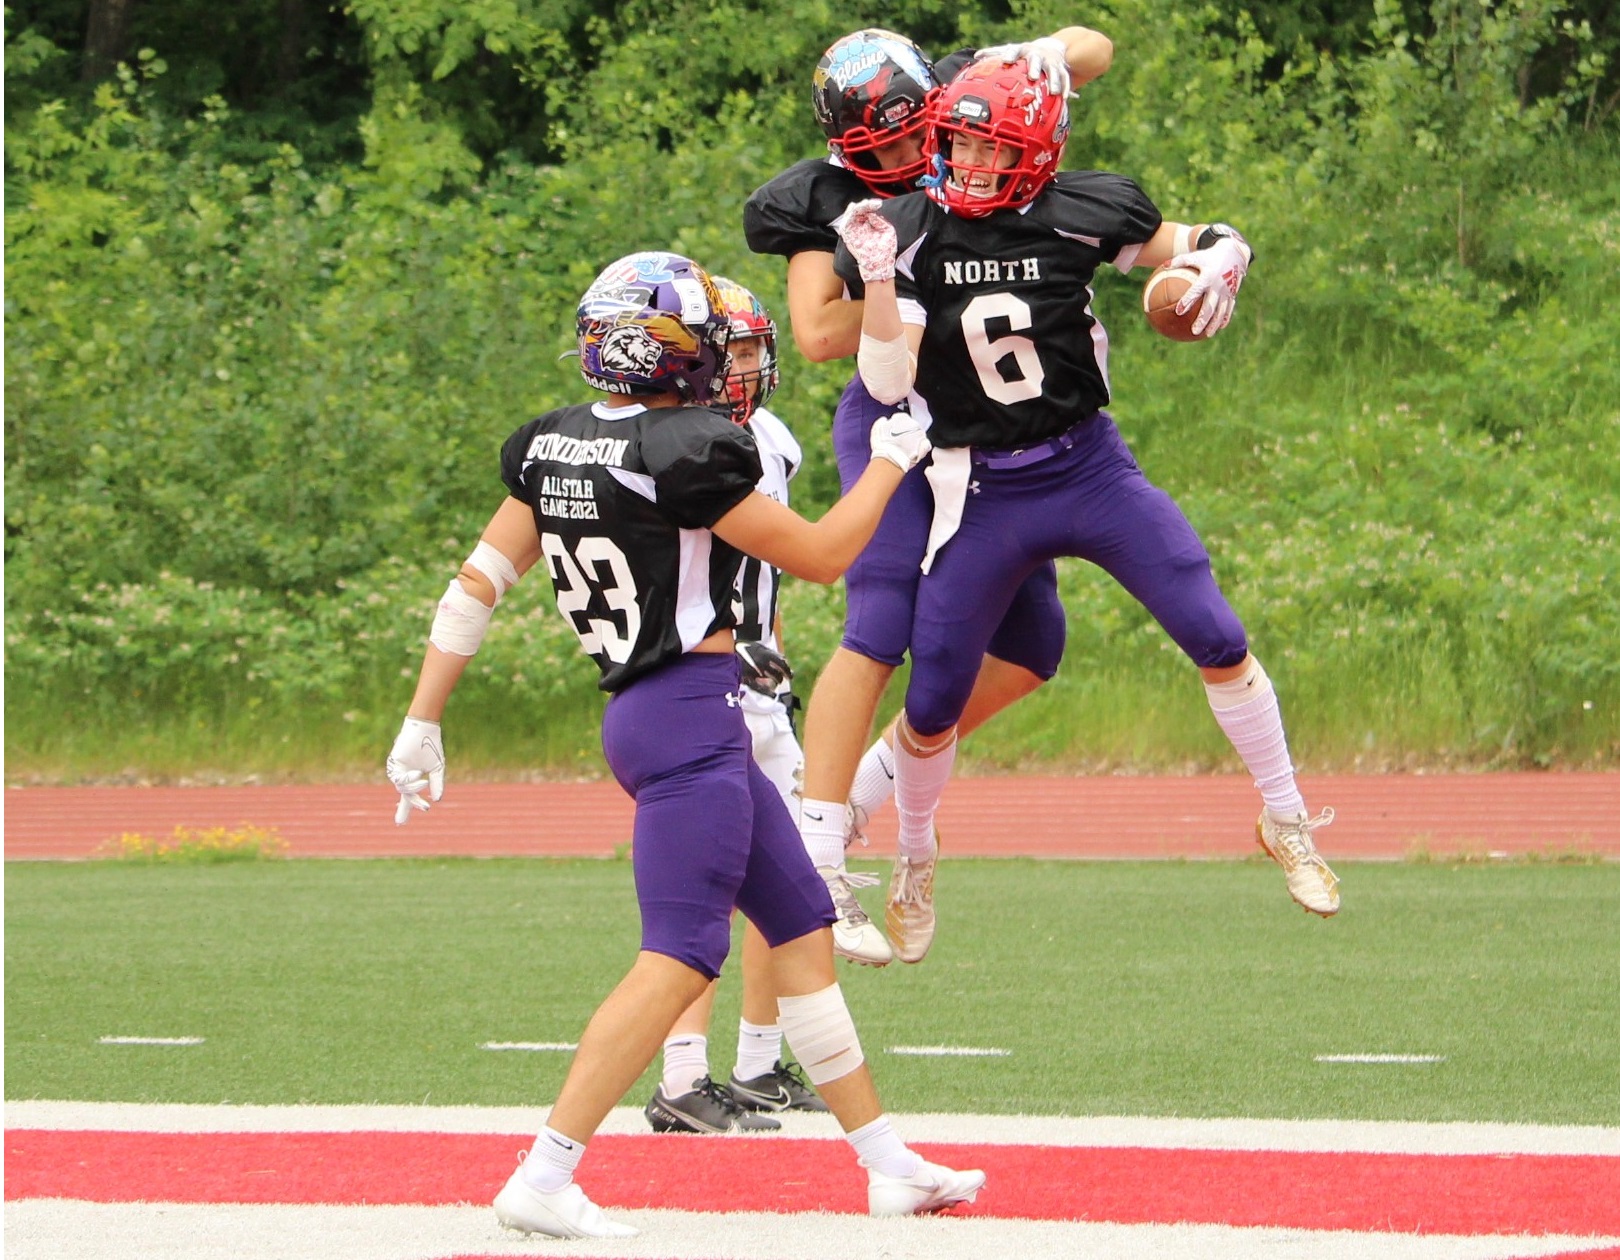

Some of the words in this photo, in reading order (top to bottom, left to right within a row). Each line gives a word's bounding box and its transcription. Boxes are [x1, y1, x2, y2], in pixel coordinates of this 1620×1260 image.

[833, 49, 887, 92] Blaine
[944, 257, 1041, 285] NORTH
[961, 292, 1045, 406] 6
[540, 498, 569, 519] GAME
[569, 500, 600, 520] 2021
[540, 532, 641, 665] 23
